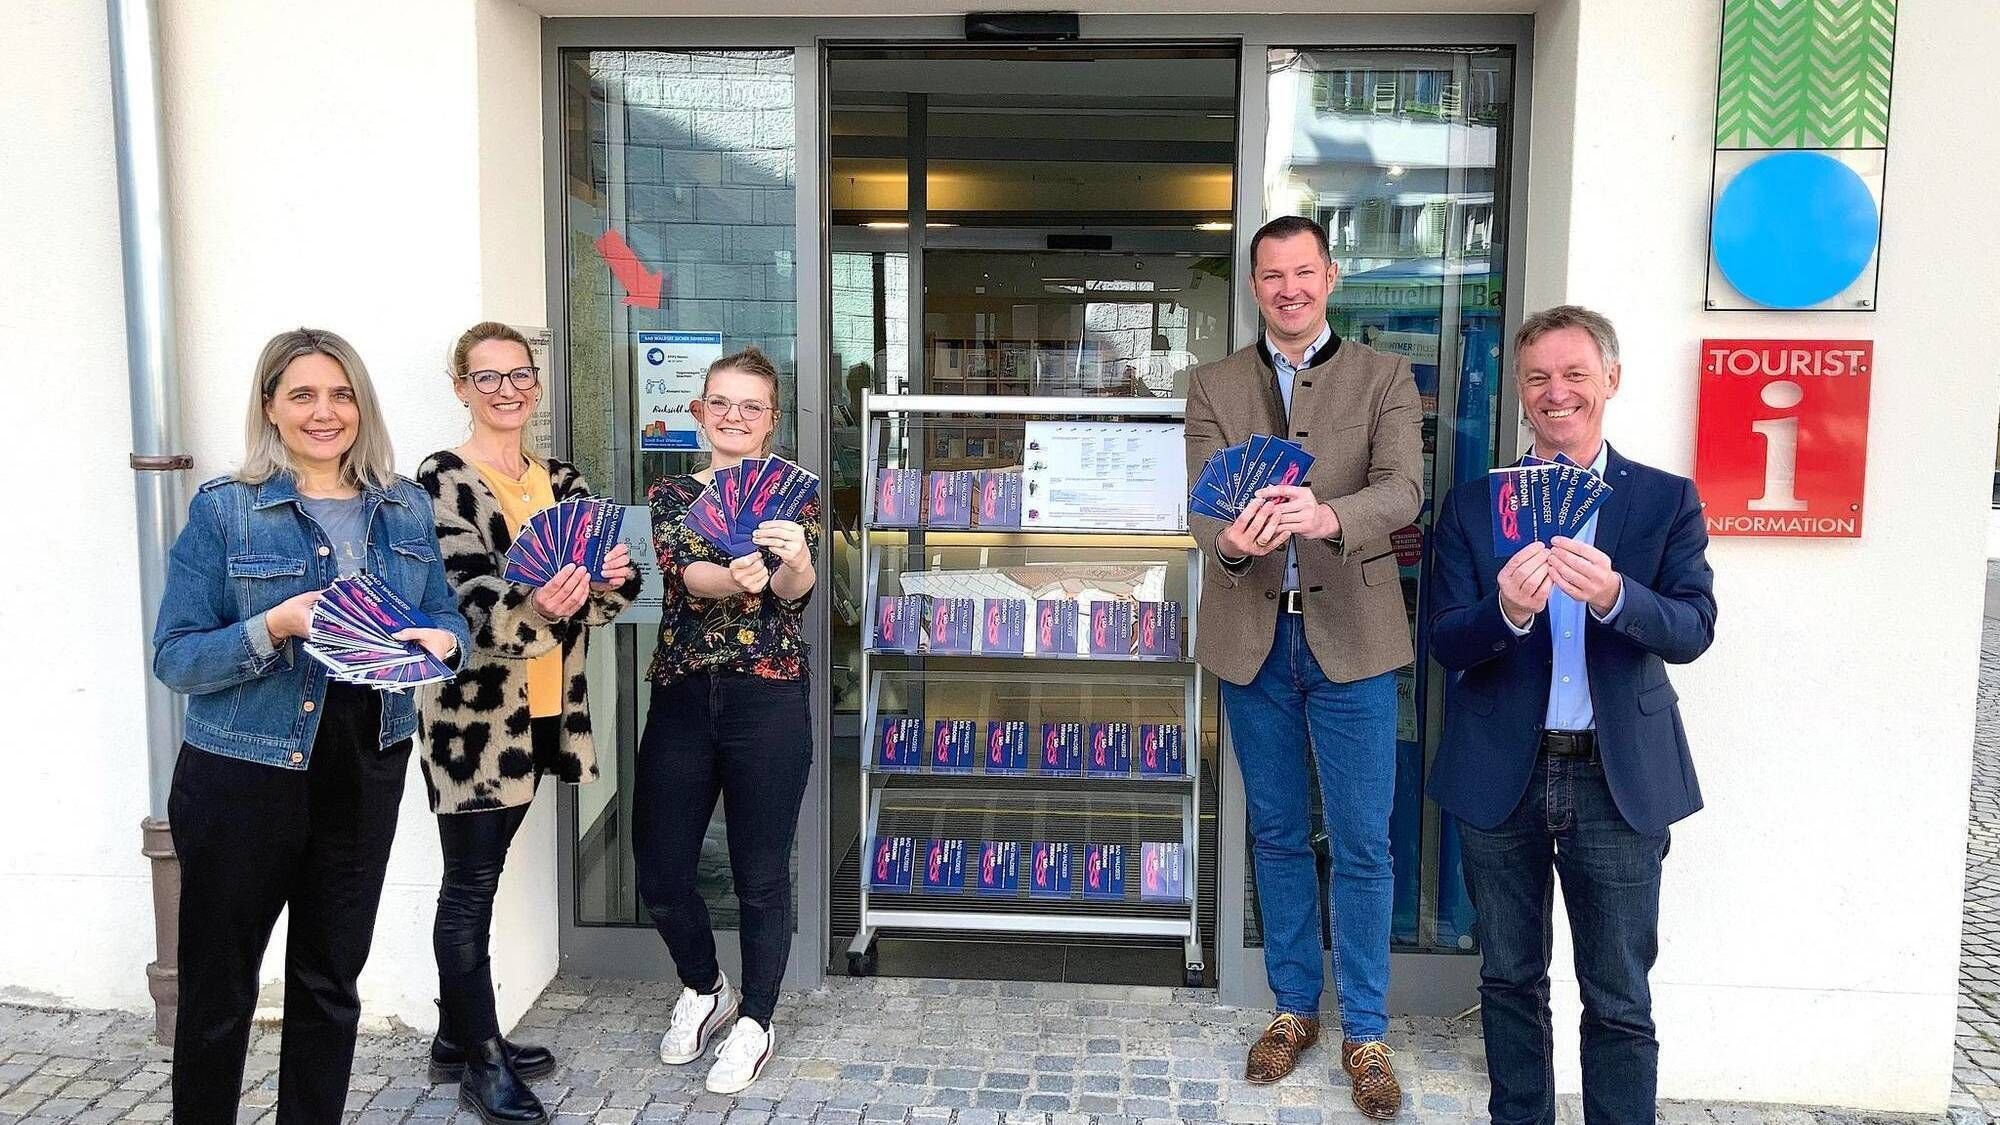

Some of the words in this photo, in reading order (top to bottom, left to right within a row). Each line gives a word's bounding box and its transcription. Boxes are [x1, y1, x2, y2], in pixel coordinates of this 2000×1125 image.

[1709, 349, 1865, 377] TOURIST
[1747, 380, 1809, 512] i
[778, 466, 800, 496] TURSONN
[1560, 466, 1570, 481] KUL
[1570, 468, 1581, 486] BAD
[769, 482, 780, 494] TAG
[1520, 469, 1528, 506] TURSONN
[1584, 476, 1599, 490] KUL
[1592, 482, 1606, 498] BAD
[1510, 495, 1518, 511] TAG
[1542, 486, 1552, 524] WALDSEER
[584, 524, 594, 538] TAG
[1706, 516, 1855, 534] NFORMATION
